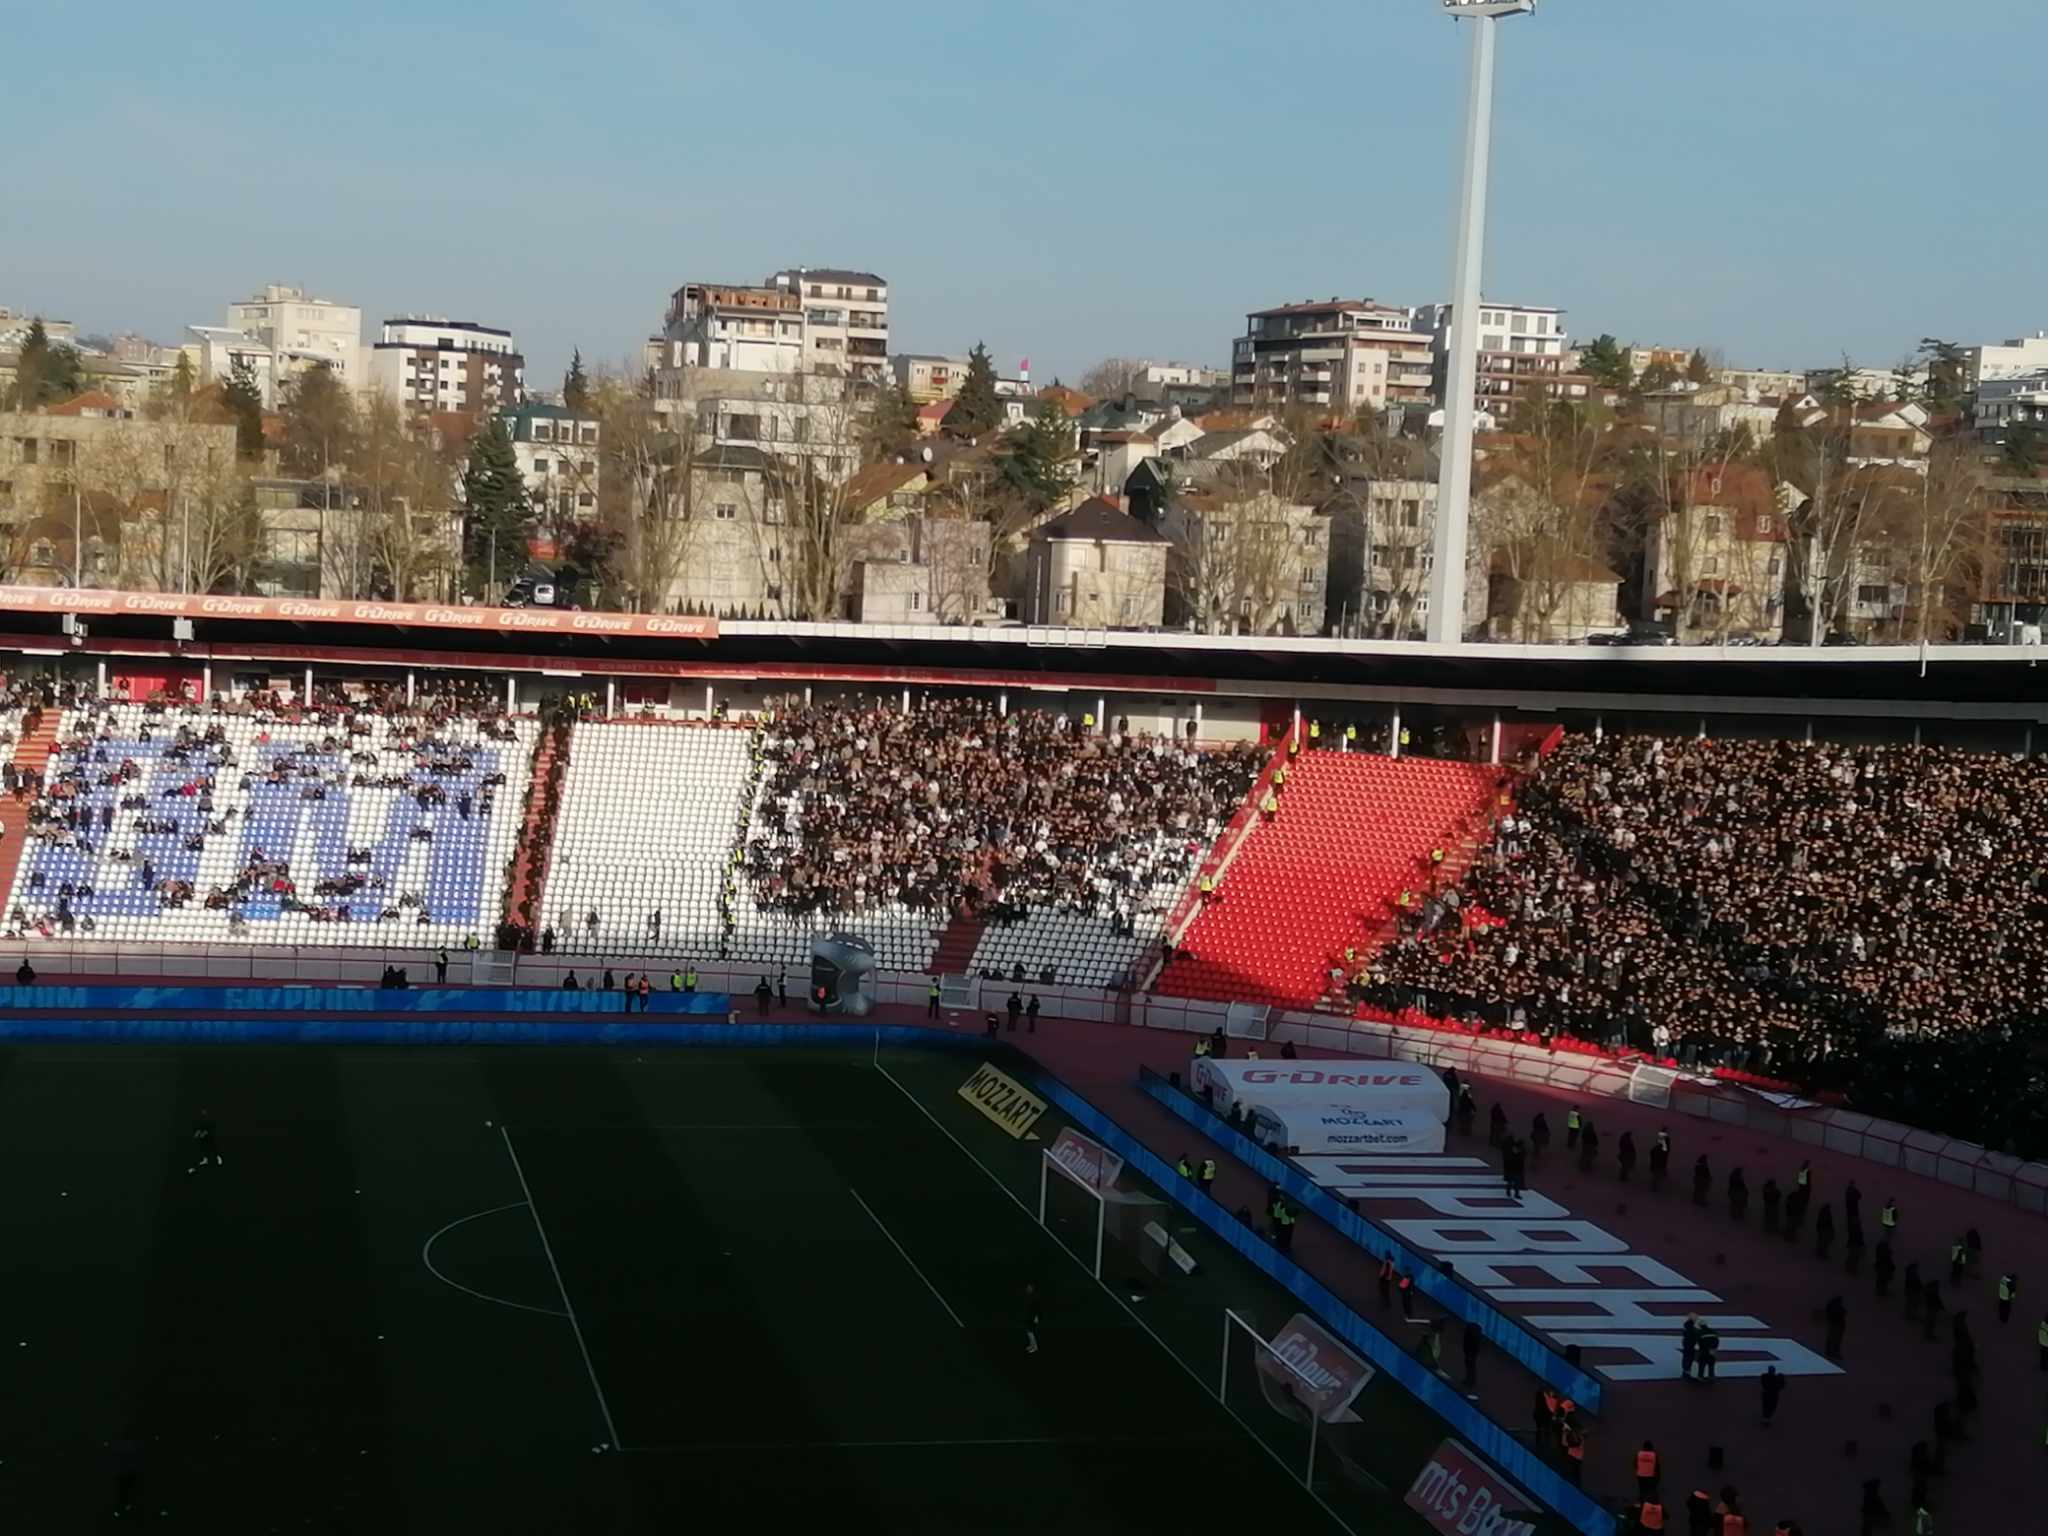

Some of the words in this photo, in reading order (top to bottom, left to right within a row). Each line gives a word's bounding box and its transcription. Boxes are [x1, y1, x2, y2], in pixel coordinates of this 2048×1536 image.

[963, 1069, 1041, 1129] MOZZART
[1327, 1133, 1409, 1144] mozzartbet.com
[1413, 1460, 1468, 1520] mts
